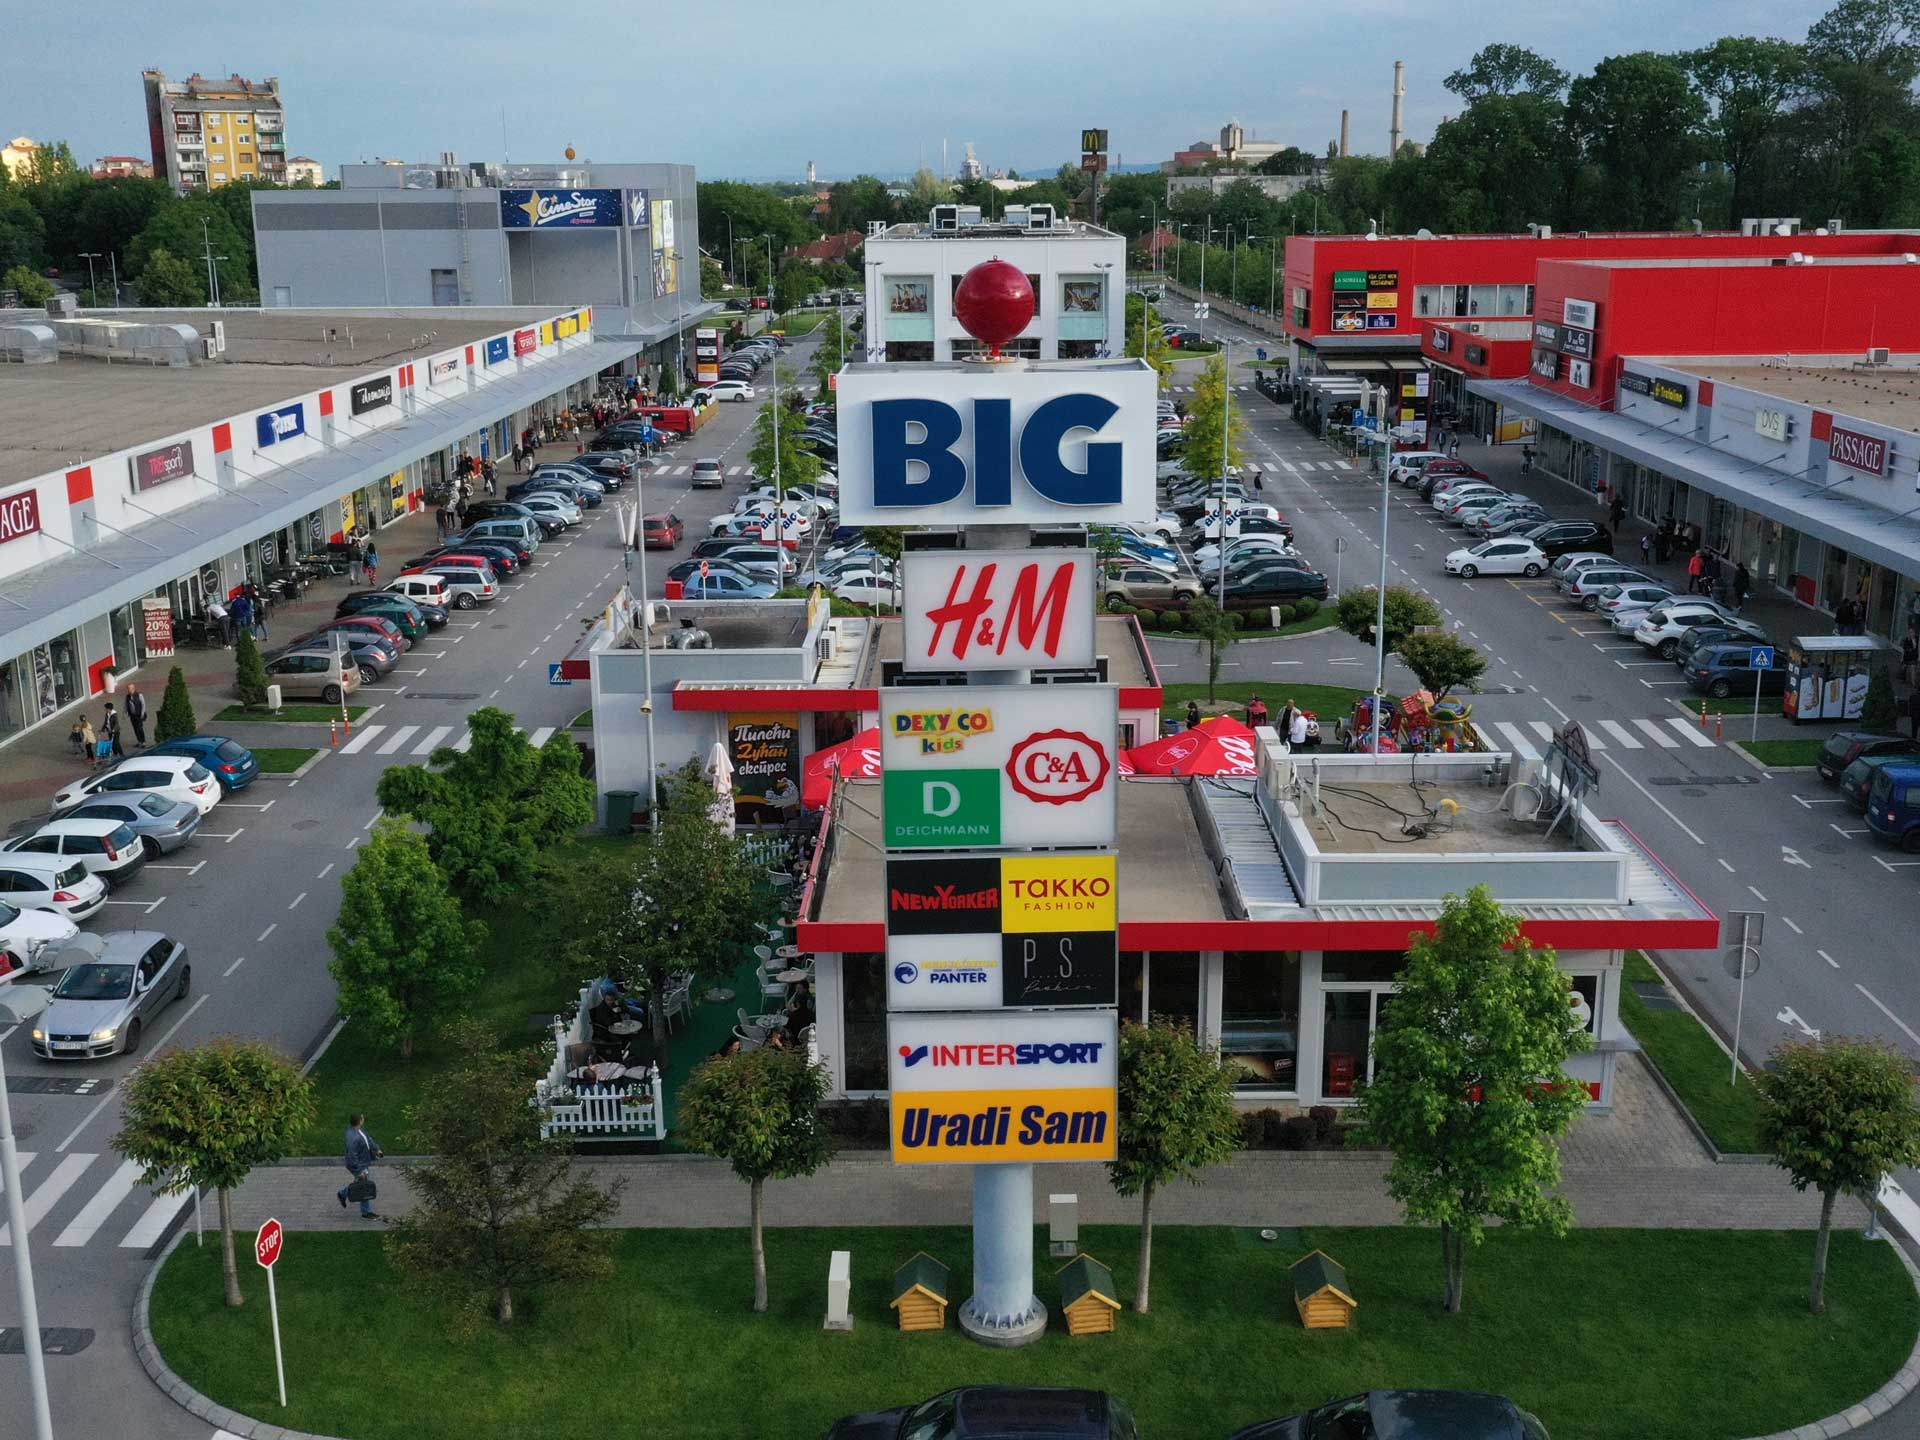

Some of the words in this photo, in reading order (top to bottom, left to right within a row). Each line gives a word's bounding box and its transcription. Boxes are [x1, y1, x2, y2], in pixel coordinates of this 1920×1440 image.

[537, 192, 597, 218] CineStar
[1762, 408, 1780, 431] OVS
[871, 393, 1123, 507] BIG
[1832, 432, 1882, 470] PASSAGE
[783, 513, 798, 530] BIG
[926, 562, 1074, 660] H&M
[146, 620, 170, 631] 20%
[734, 722, 791, 743] Пилећи
[896, 713, 951, 732] DEXY
[957, 713, 988, 730] CO
[922, 738, 963, 753] kids
[1025, 751, 1090, 784] C&A
[923, 781, 961, 817] D
[895, 825, 990, 836] DEICHMANN
[1024, 902, 1095, 911] FASHION
[930, 973, 987, 984] PANTER
[933, 1043, 1103, 1066] INTERSPORT
[902, 1106, 1011, 1148] Uradi
[1018, 1105, 1107, 1145] Sam
[260, 1229, 279, 1257] STOP
